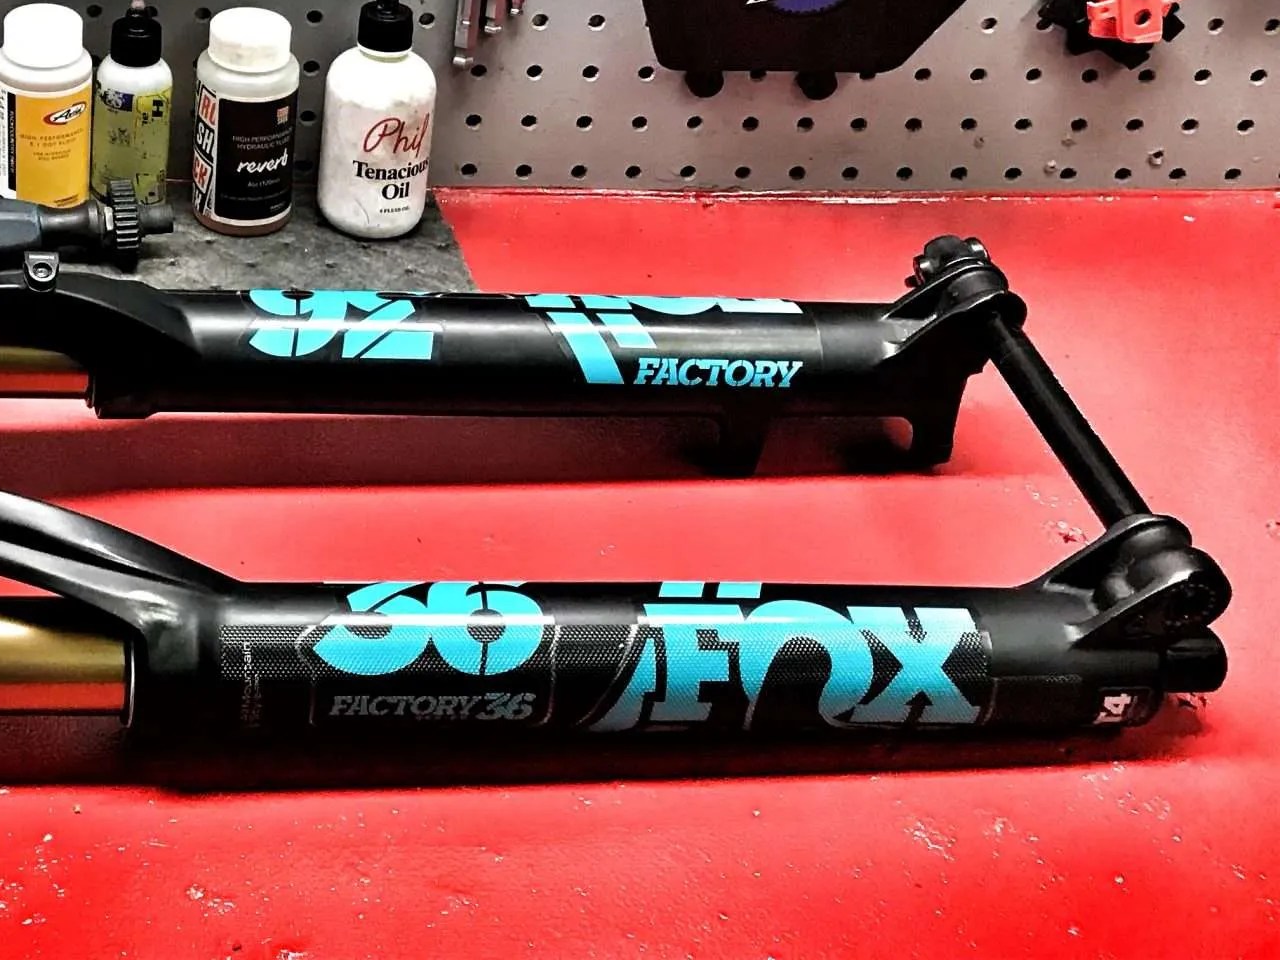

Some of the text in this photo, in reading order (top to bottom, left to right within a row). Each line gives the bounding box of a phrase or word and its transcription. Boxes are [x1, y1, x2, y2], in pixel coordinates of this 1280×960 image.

[363, 112, 430, 158] Phil
[236, 147, 288, 173] reverb
[381, 181, 410, 200] Oil
[633, 358, 803, 388] FACTORY
[620, 598, 981, 724] FOX
[318, 695, 476, 717] FACTORY
